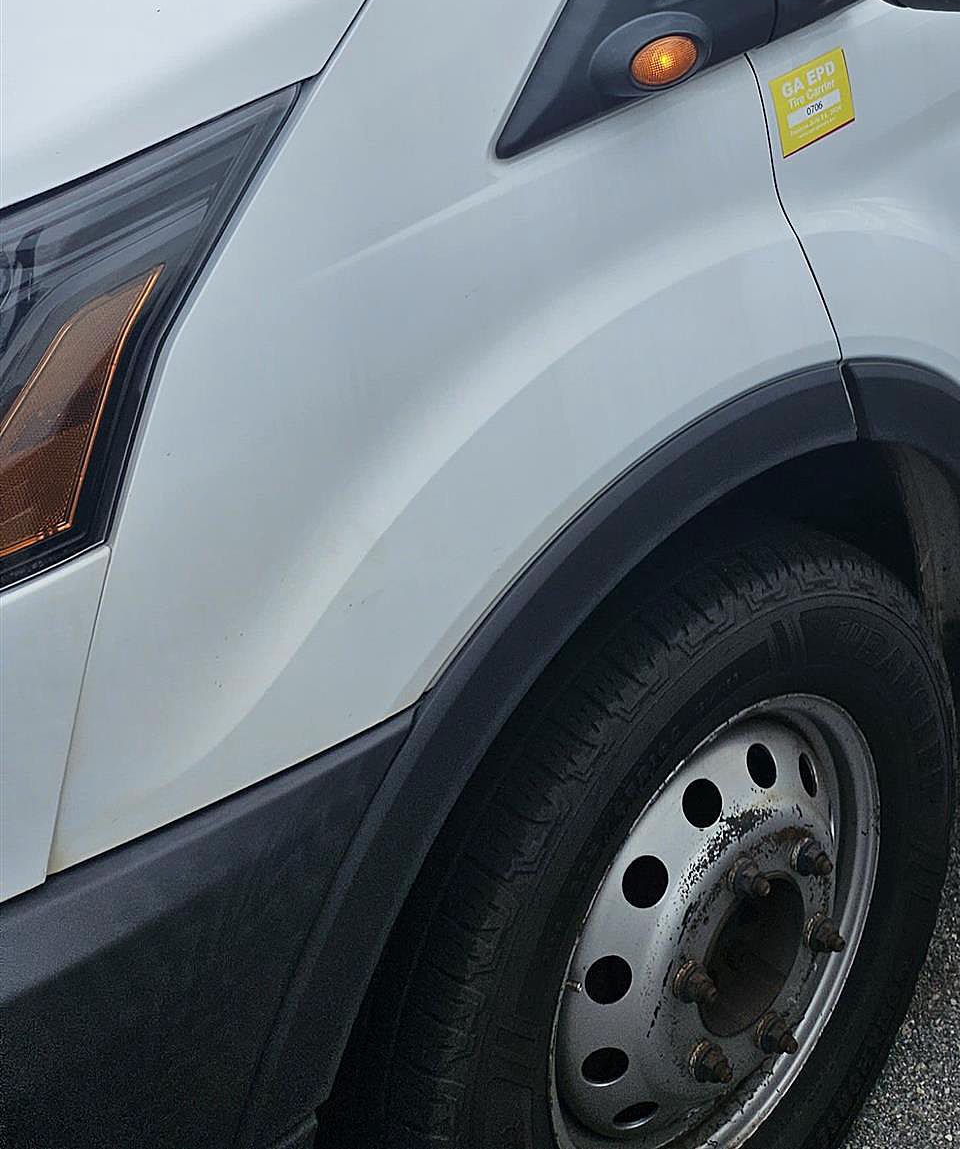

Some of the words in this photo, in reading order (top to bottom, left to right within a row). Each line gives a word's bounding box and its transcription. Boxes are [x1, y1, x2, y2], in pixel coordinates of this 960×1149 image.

[782, 77, 804, 97] GA
[806, 60, 835, 84] EPD
[806, 100, 823, 116] 0706
